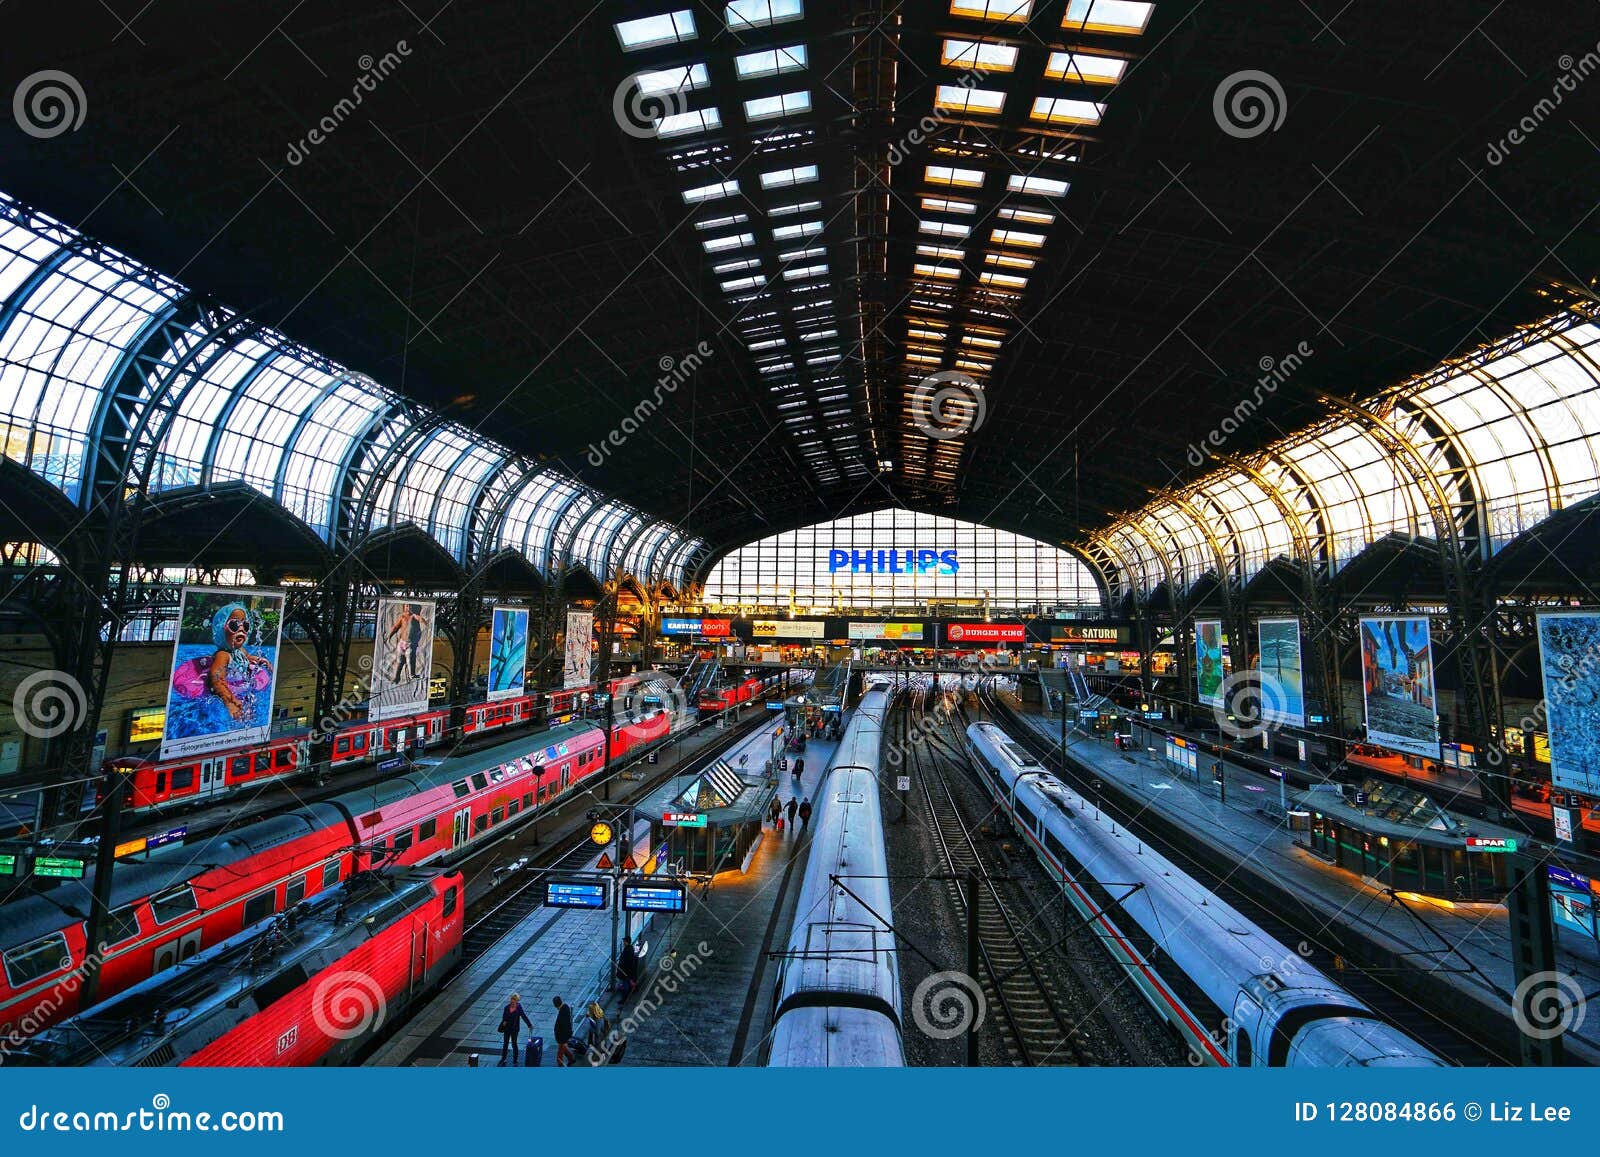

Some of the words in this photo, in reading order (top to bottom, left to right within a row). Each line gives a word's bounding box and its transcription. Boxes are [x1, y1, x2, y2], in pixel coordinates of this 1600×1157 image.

[829, 550, 960, 574] PHILIPS
[703, 623, 726, 631] sports
[1081, 628, 1118, 640] SATURN
[1356, 792, 1364, 803] E
[1570, 795, 1578, 806] E
[670, 814, 697, 822] SPAR
[1475, 839, 1505, 847] SPAR
[278, 1026, 298, 1054] DB
